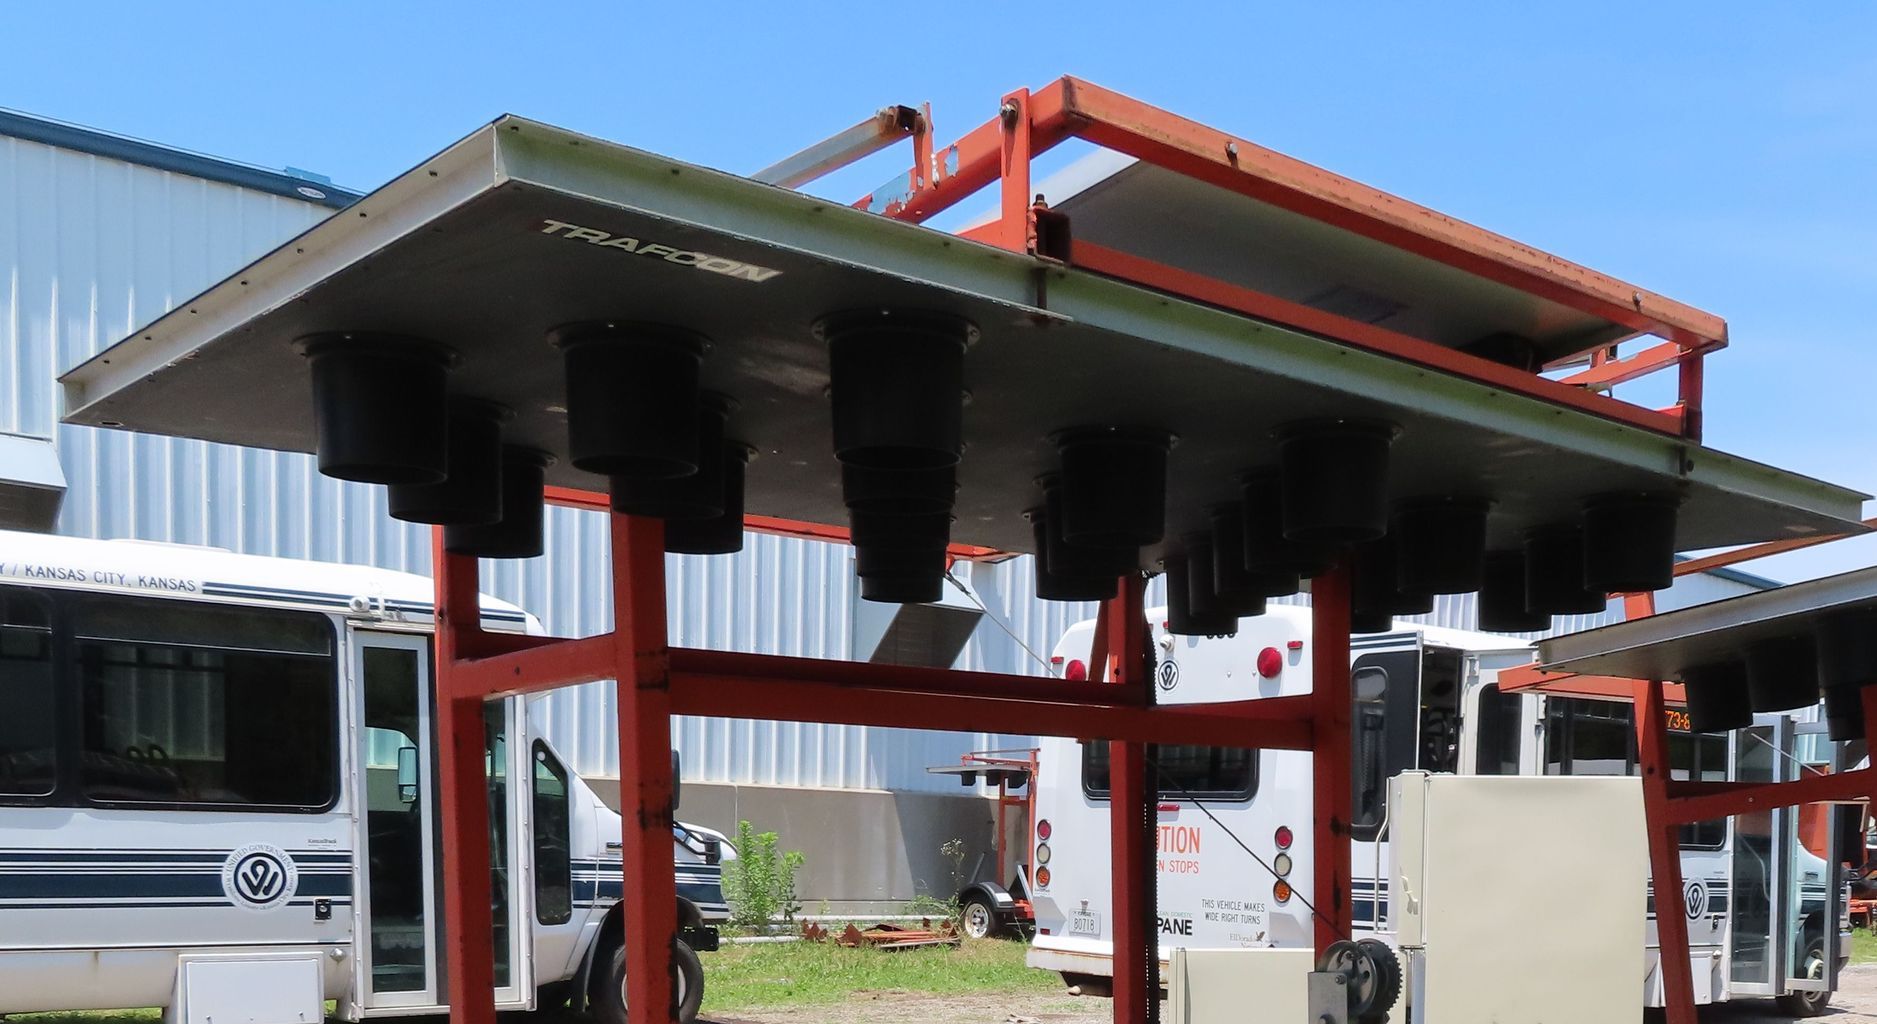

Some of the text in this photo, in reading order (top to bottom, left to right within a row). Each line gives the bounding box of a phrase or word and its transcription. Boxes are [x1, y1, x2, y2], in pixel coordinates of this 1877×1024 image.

[542, 219, 784, 282] TRAFCON
[25, 564, 86, 582] KANSAS
[138, 575, 196, 592] KANSAS
[1664, 710, 1690, 730] 73-8
[1169, 860, 1199, 874] STOPS
[1202, 899, 1265, 913] THIS VEHICLE MAKES
[1205, 912, 1261, 925] WIDE RIGHT TURNS
